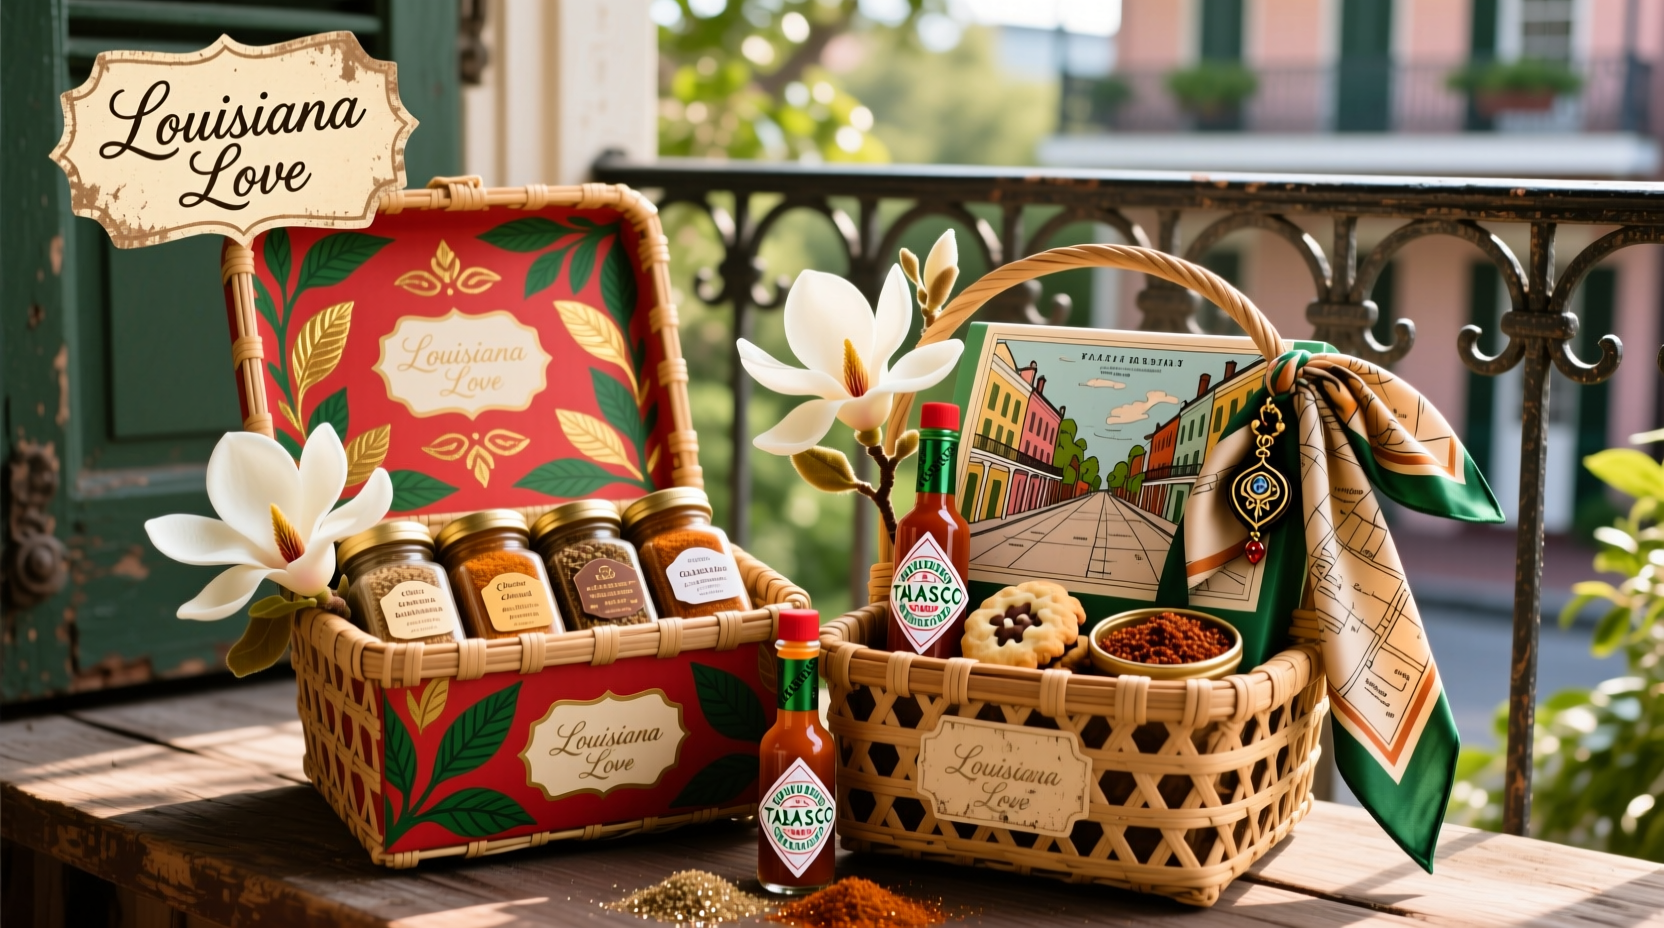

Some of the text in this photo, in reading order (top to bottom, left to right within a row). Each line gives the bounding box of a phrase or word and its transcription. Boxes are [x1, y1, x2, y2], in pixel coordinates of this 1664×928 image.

[99, 80, 367, 161] Louisiana
[178, 142, 312, 211] Love
[397, 334, 527, 373] Louisiana
[439, 366, 504, 399] Love
[549, 720, 664, 757] Louisiana
[578, 749, 635, 780] Love
[945, 744, 1062, 787] Louisiana
[973, 781, 1030, 814] Love
